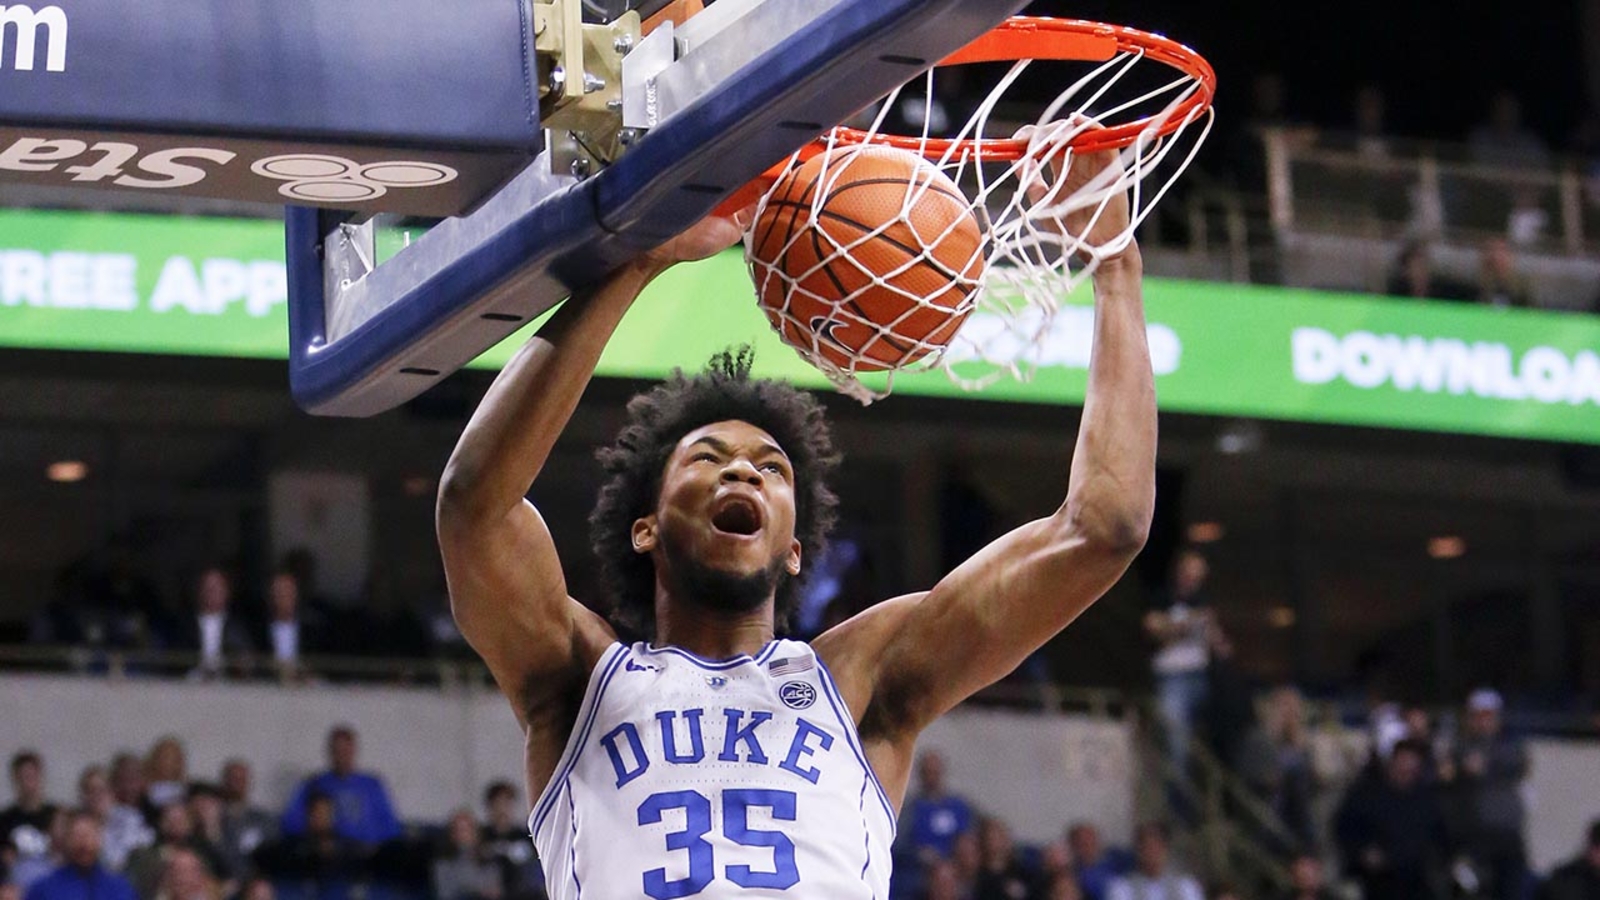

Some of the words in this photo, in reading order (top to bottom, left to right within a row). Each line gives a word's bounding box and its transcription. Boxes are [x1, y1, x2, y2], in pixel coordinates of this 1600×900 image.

[0, 4, 68, 72] m
[0, 137, 237, 188] Sta
[0, 249, 138, 310] REE
[148, 255, 287, 317] APP
[600, 708, 834, 790] DUKE
[637, 788, 800, 900] 35
